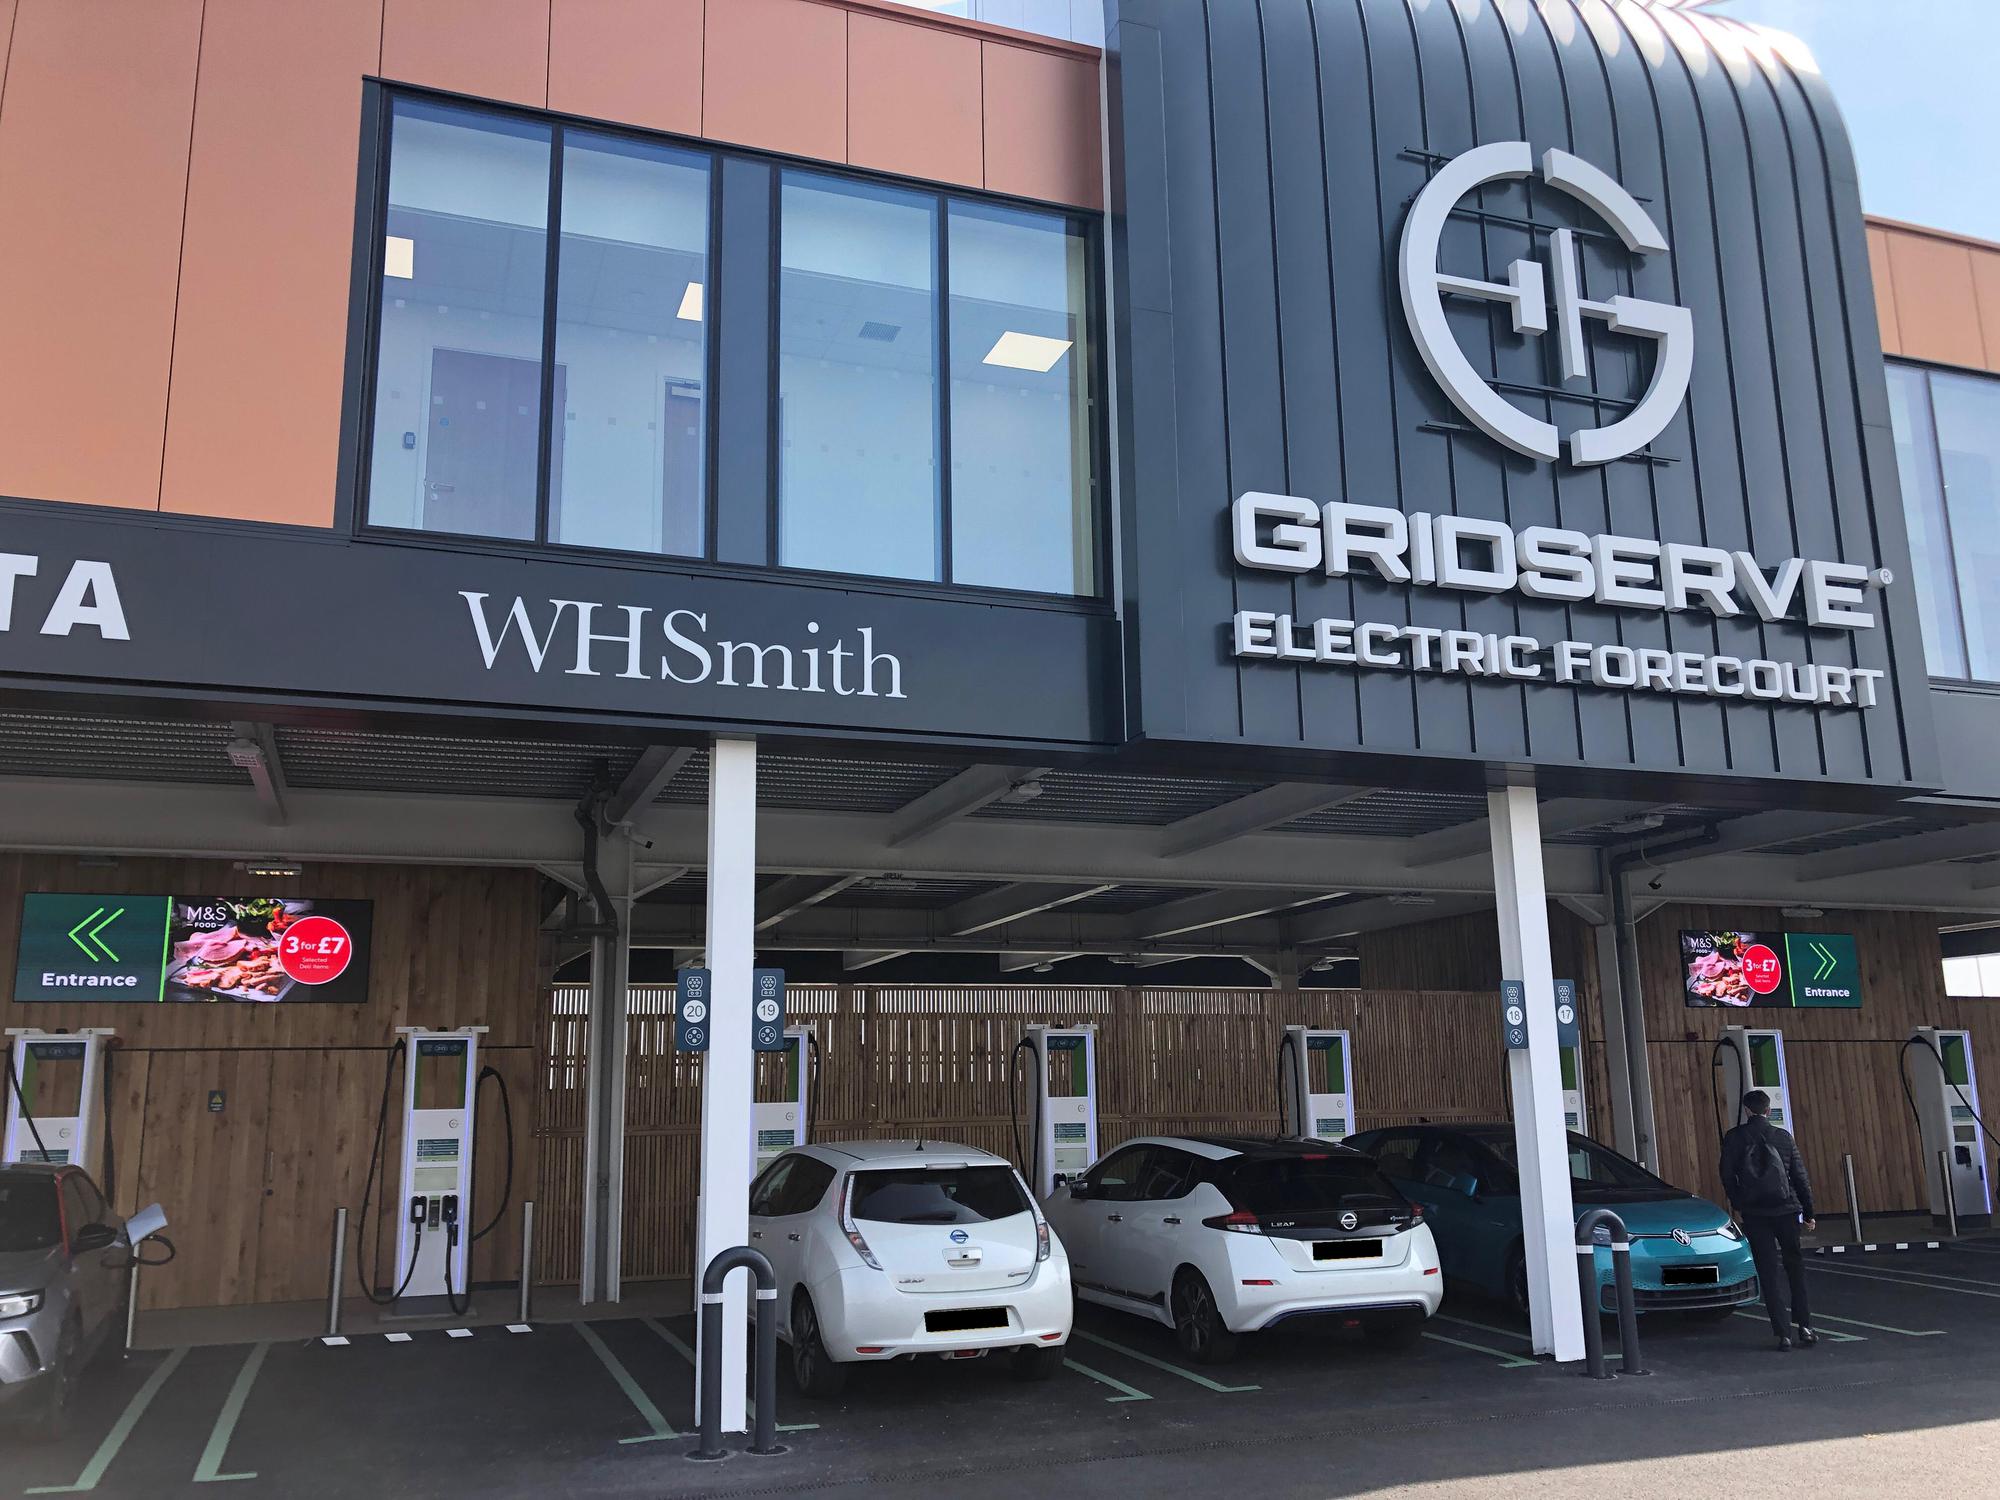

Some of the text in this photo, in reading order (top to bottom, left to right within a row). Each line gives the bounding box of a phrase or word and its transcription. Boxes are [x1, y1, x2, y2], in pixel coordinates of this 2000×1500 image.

[458, 590, 908, 699] WHSmith
[1234, 610, 1884, 709] ELECTRIC FORECOURT
[186, 905, 227, 921] M&S
[286, 936, 345, 955] 3 for £7
[1690, 937, 1712, 949] M&S
[302, 956, 328, 964] Selected
[1744, 959, 1754, 972] 3
[1762, 959, 1776, 973] £7
[41, 972, 138, 988] Entrance
[1804, 987, 1850, 997] Entrance
[686, 1005, 703, 1018] 20
[761, 1004, 776, 1016] 19
[1509, 1010, 1521, 1021] 18
[1561, 1009, 1572, 1020] 17
